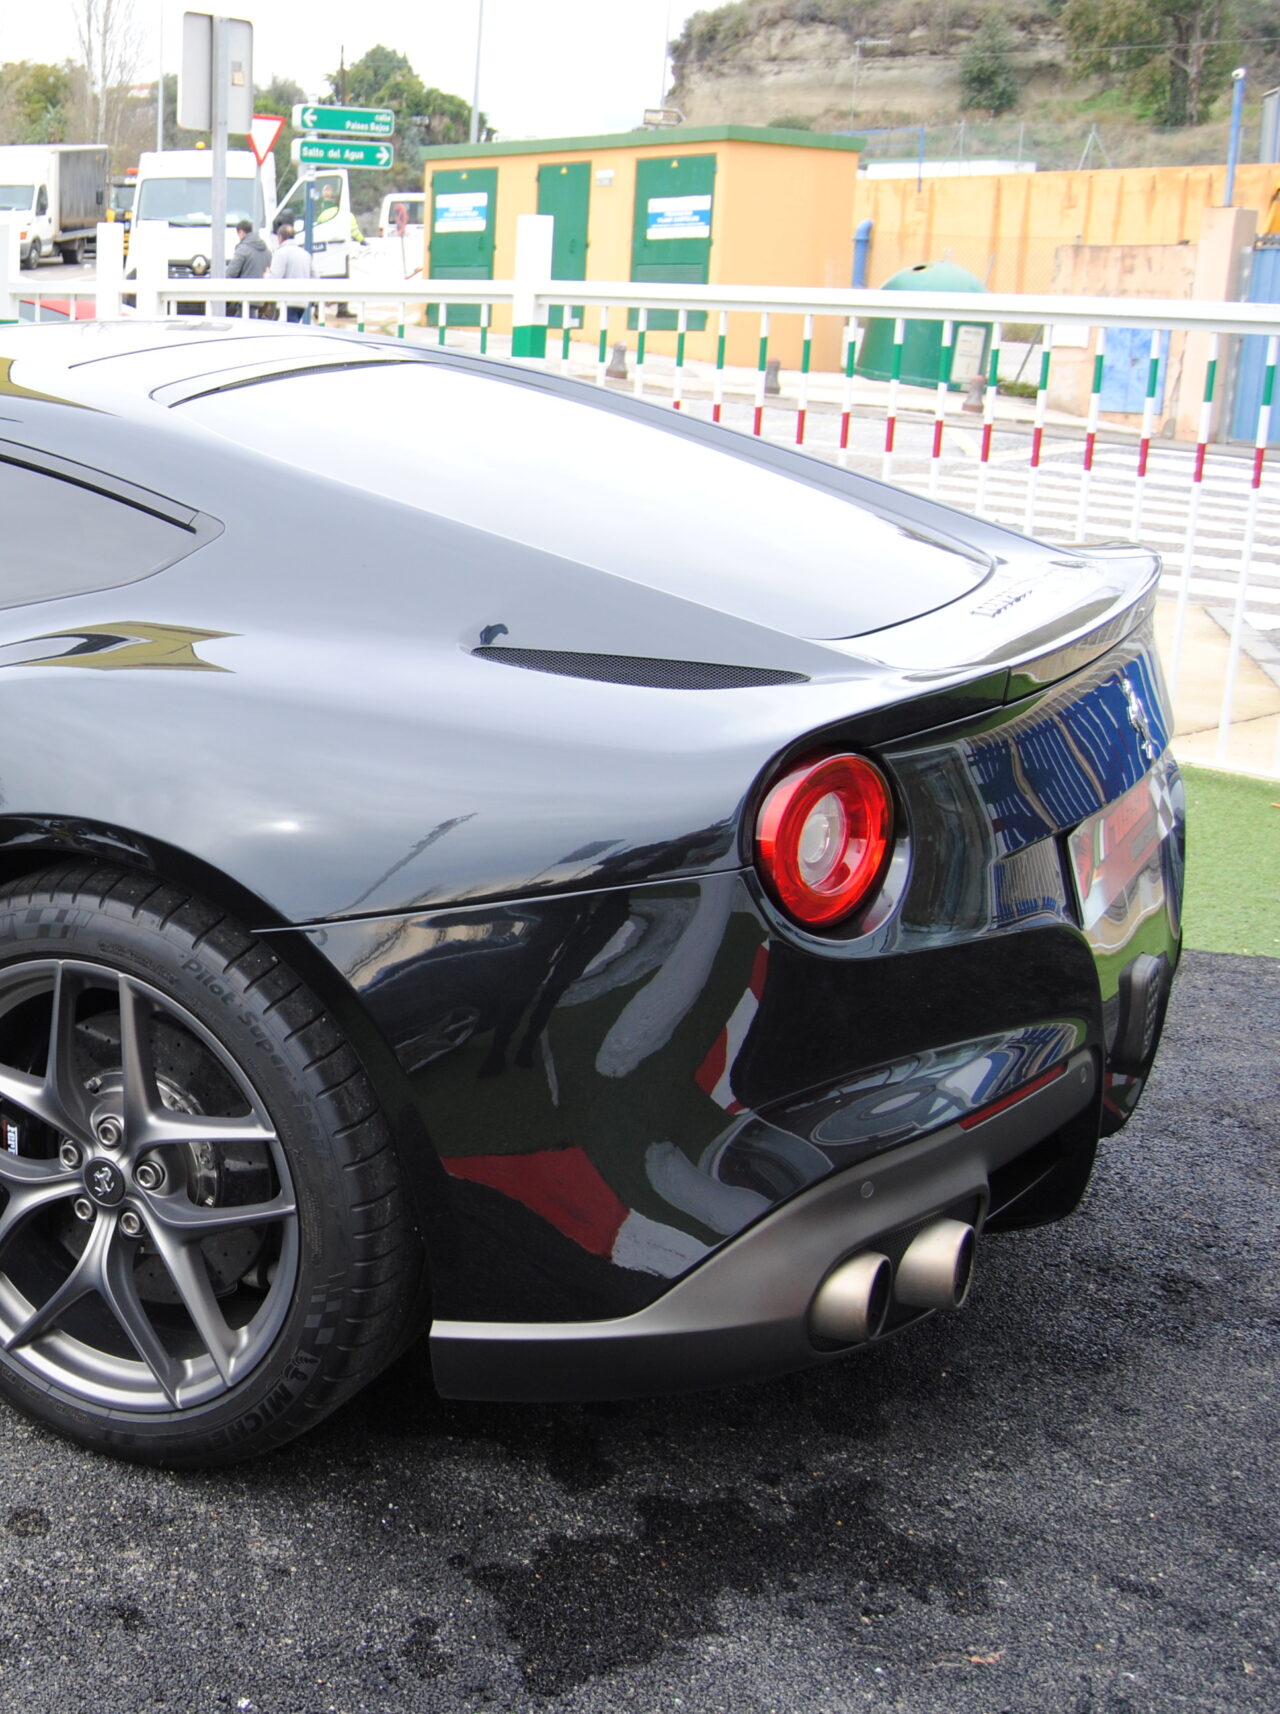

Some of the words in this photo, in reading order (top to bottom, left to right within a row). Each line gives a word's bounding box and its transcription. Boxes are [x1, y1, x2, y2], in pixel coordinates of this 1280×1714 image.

[302, 146, 325, 158] Salto
[327, 148, 341, 159] del
[344, 149, 365, 161] Agua
[181, 957, 236, 1005] Pilot
